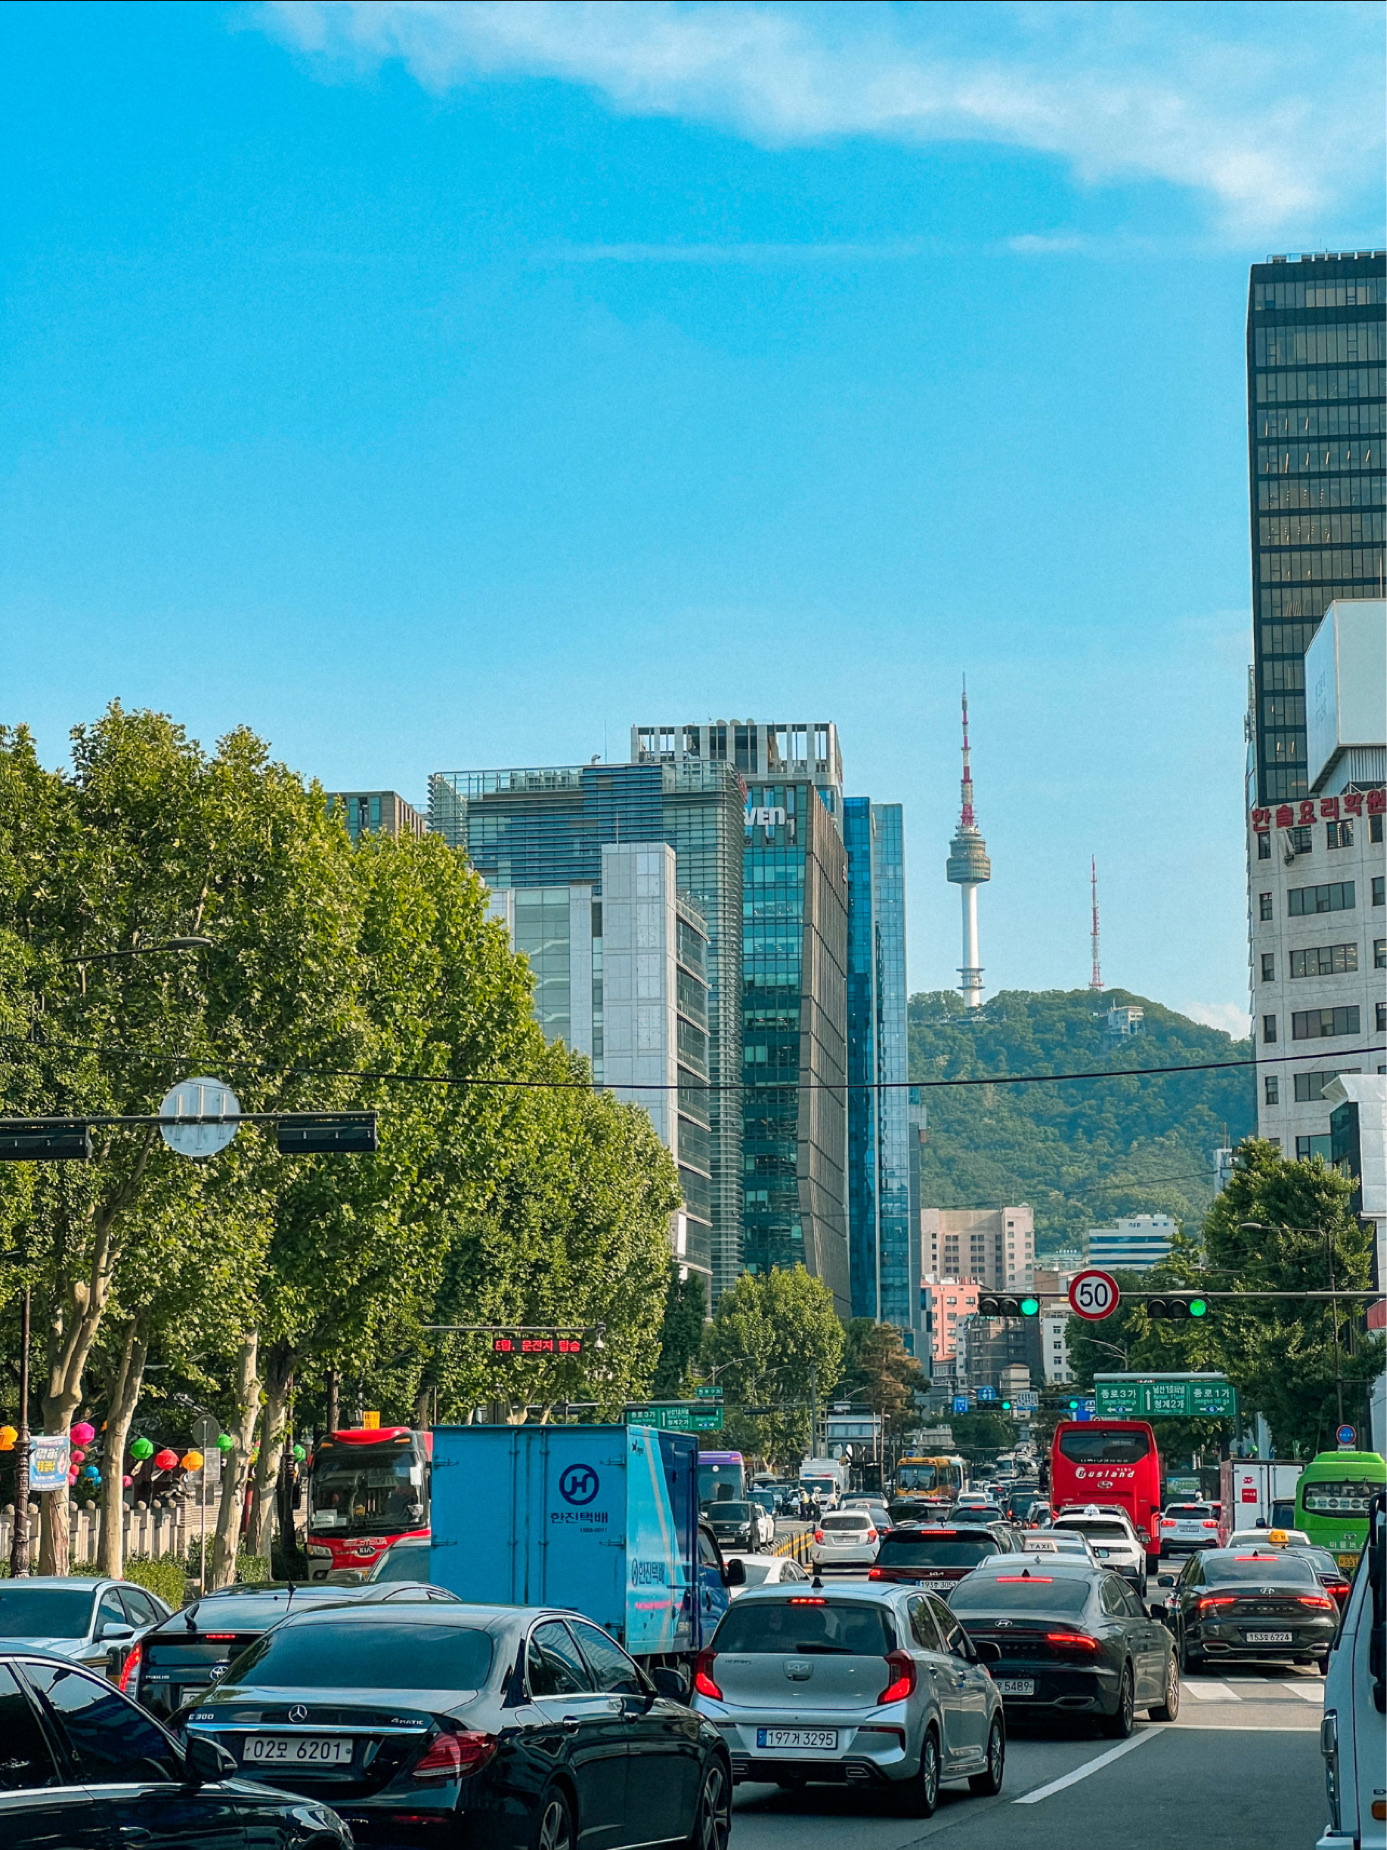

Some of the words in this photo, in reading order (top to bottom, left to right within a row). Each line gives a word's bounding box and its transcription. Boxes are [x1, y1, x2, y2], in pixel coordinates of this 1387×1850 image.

[1251, 788, 1387, 832] 한솔요리학원
[1079, 1283, 1108, 1307] 50
[521, 1339, 554, 1352] 운전자
[1100, 1388, 1137, 1399] 종로3가
[1193, 1388, 1230, 1398] 종로1가
[550, 1511, 609, 1524] 한진택배
[638, 1560, 666, 1585] 한진택배
[1004, 1681, 1030, 1692] 5489
[803, 1732, 834, 1746] 3295
[253, 1740, 288, 1759] 02모
[296, 1741, 341, 1760] 6201
